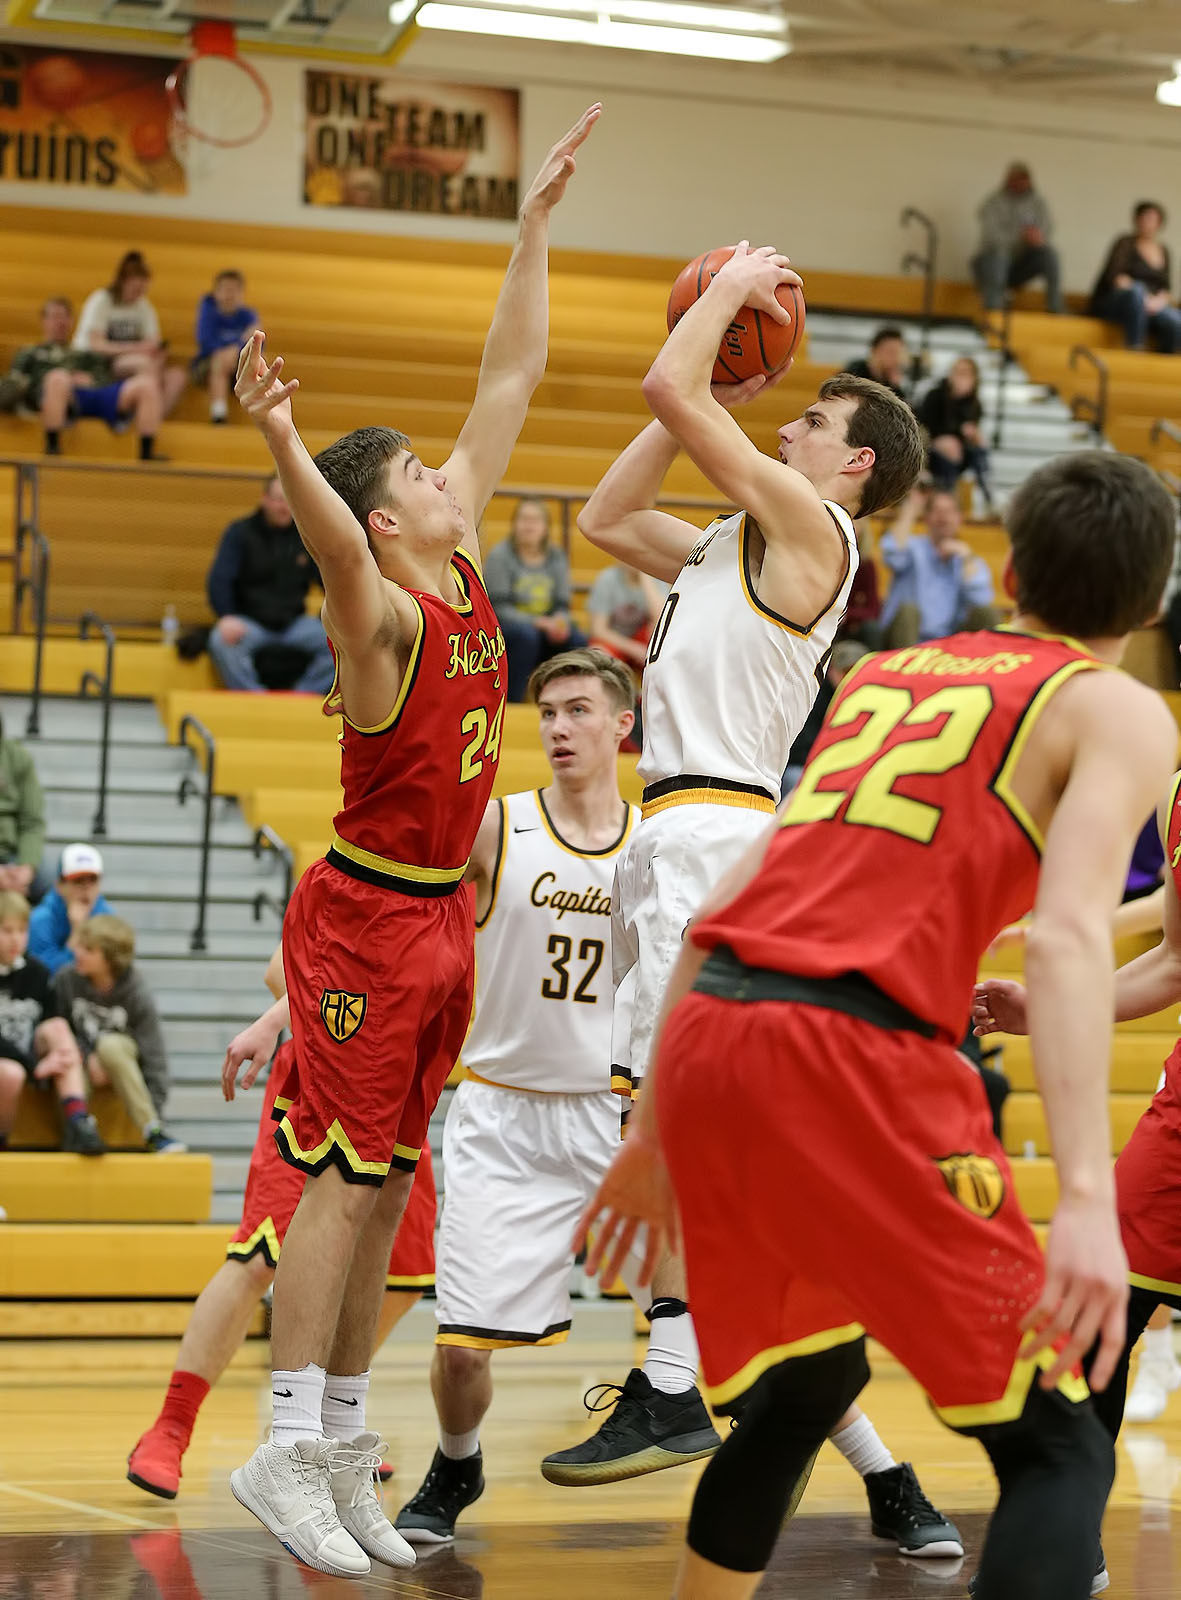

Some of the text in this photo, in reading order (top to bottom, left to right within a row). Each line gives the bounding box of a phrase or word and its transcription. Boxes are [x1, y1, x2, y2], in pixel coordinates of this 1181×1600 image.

[306, 74, 383, 120] ONE
[317, 125, 386, 169] ONE
[385, 103, 485, 153] TEAM
[384, 169, 518, 220] DREAM
[459, 693, 506, 784] 24
[778, 682, 994, 845] 22
[530, 871, 612, 920] Capita
[541, 934, 604, 1004] 32
[322, 992, 361, 1038] HK
